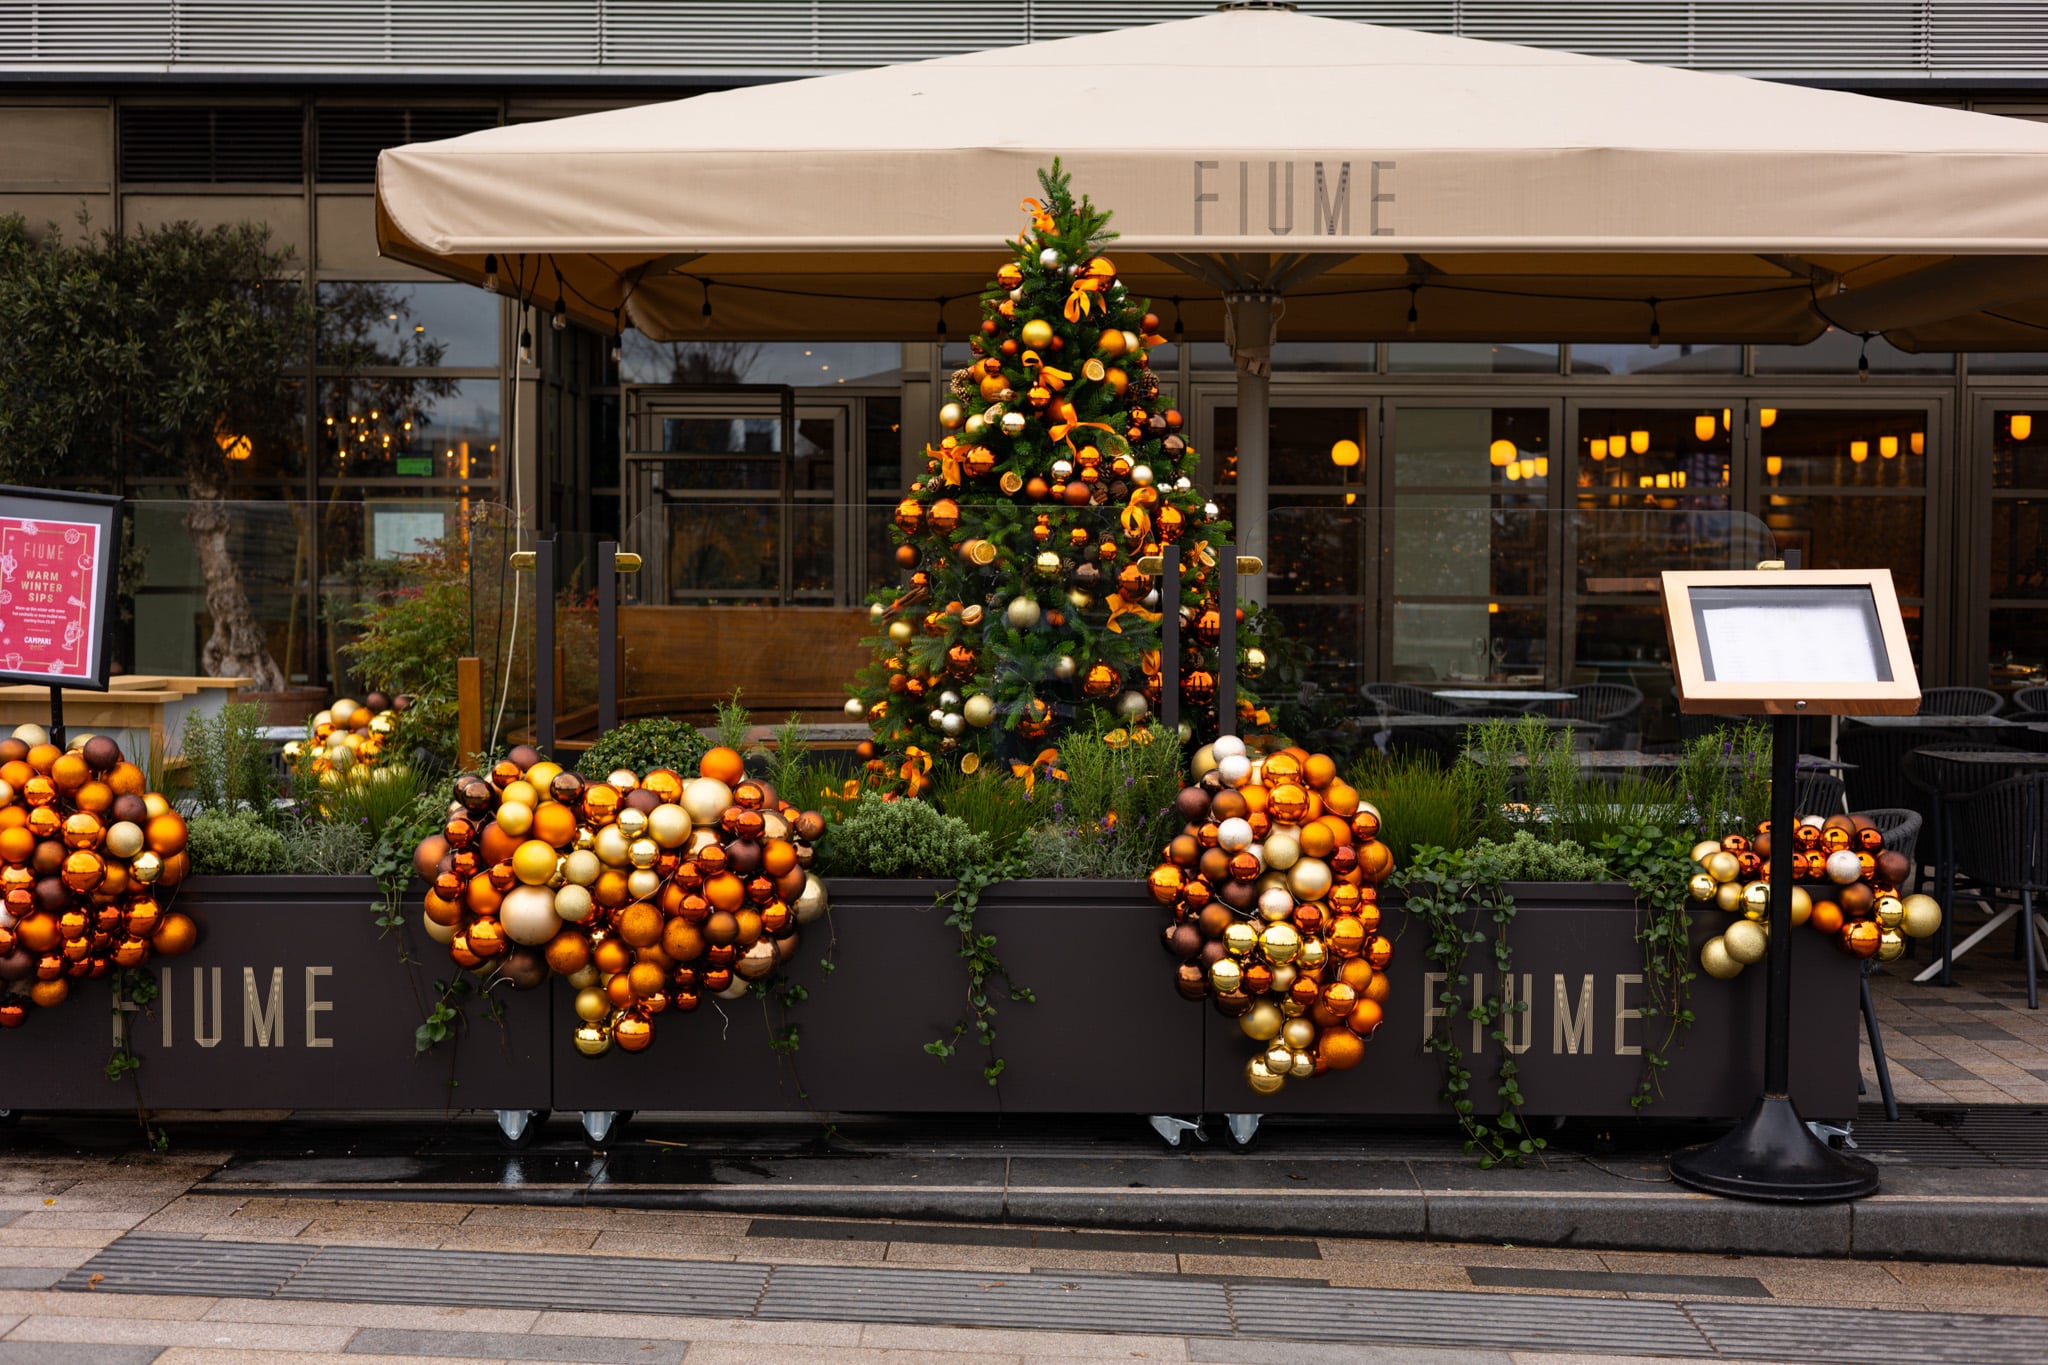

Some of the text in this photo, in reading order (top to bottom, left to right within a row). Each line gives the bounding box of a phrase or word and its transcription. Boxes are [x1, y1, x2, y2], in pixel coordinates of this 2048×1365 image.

[1194, 161, 1396, 236] FIUME
[23, 542, 65, 561] FIUME
[26, 569, 59, 581] WARM
[21, 581, 63, 593] WINTER
[28, 592, 54, 603] SIPS
[24, 636, 52, 645] CAMPARI
[1423, 972, 1643, 1055] FIUME
